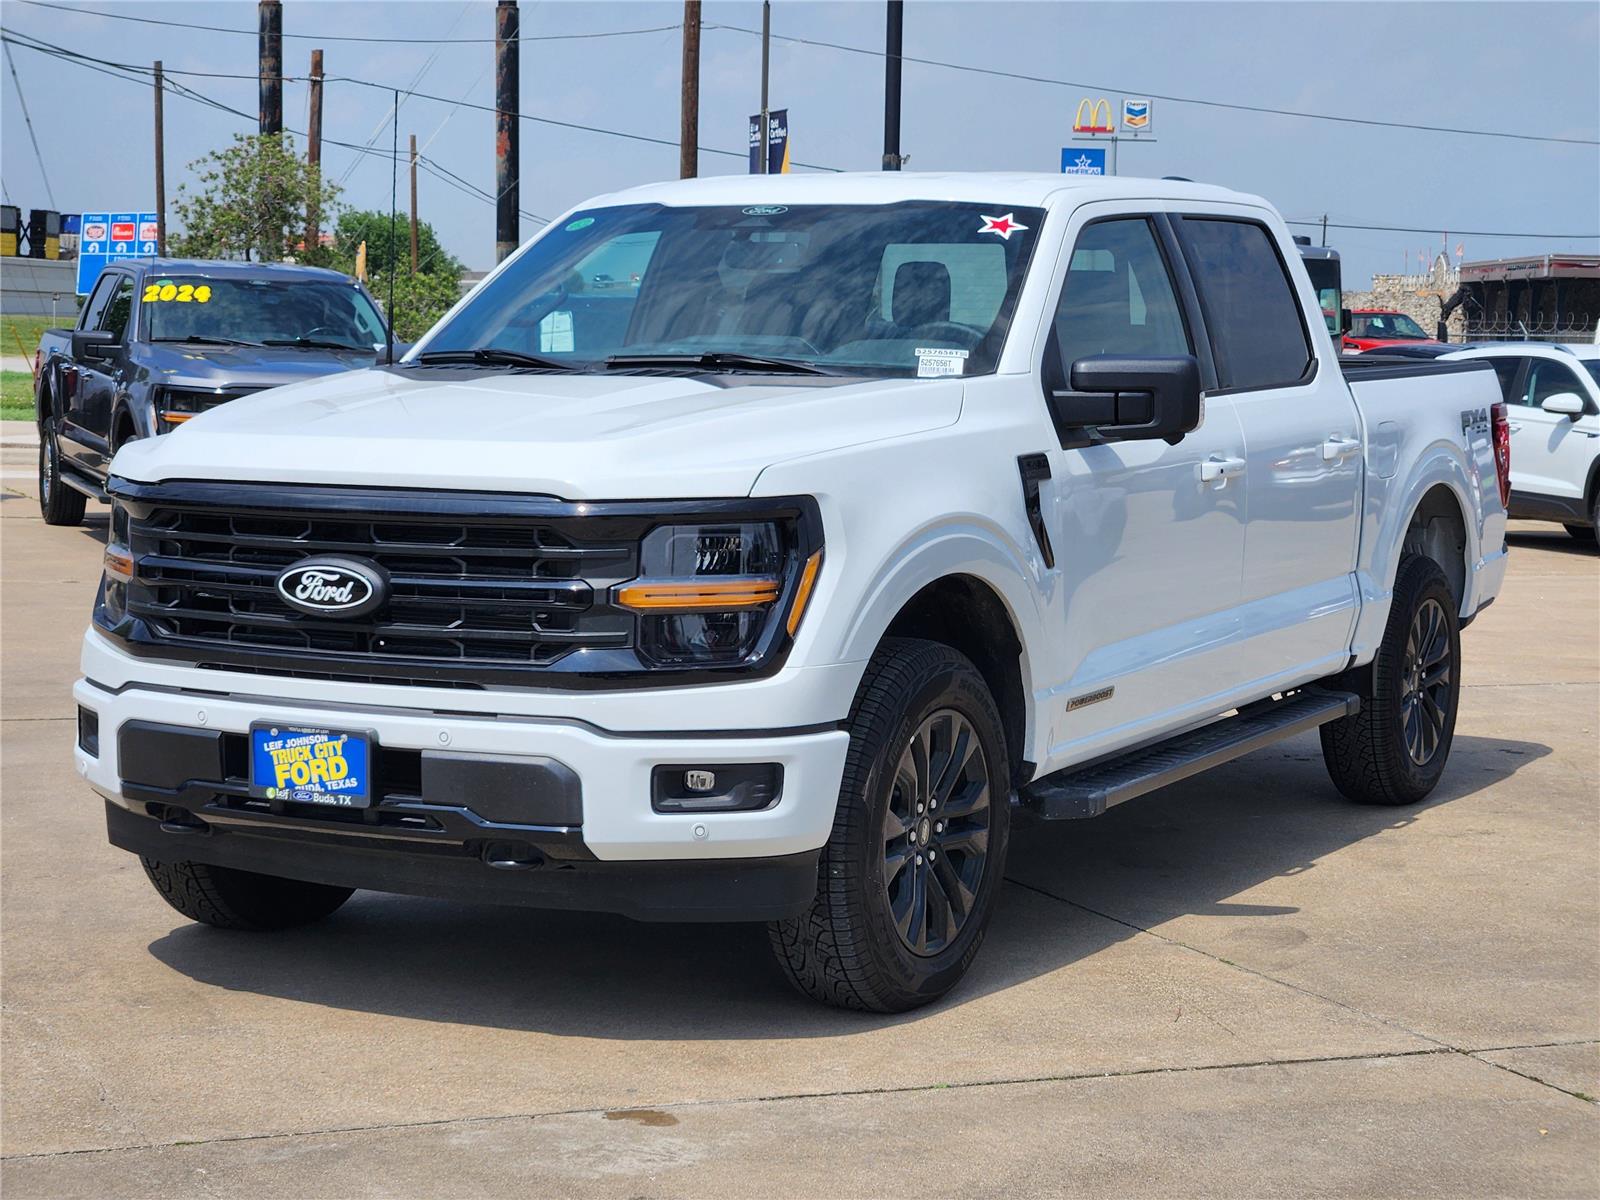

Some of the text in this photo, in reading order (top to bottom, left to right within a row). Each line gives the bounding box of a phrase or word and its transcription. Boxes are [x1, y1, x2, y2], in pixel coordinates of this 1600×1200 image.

[142, 284, 212, 303] 2024
[295, 570, 355, 603] Ford
[263, 734, 329, 752] LEIF JOHNSON
[270, 740, 344, 765] TRUCK CITY
[274, 755, 349, 789] FORD
[325, 777, 358, 791] TEXAS
[312, 793, 352, 806] Buda, TX
